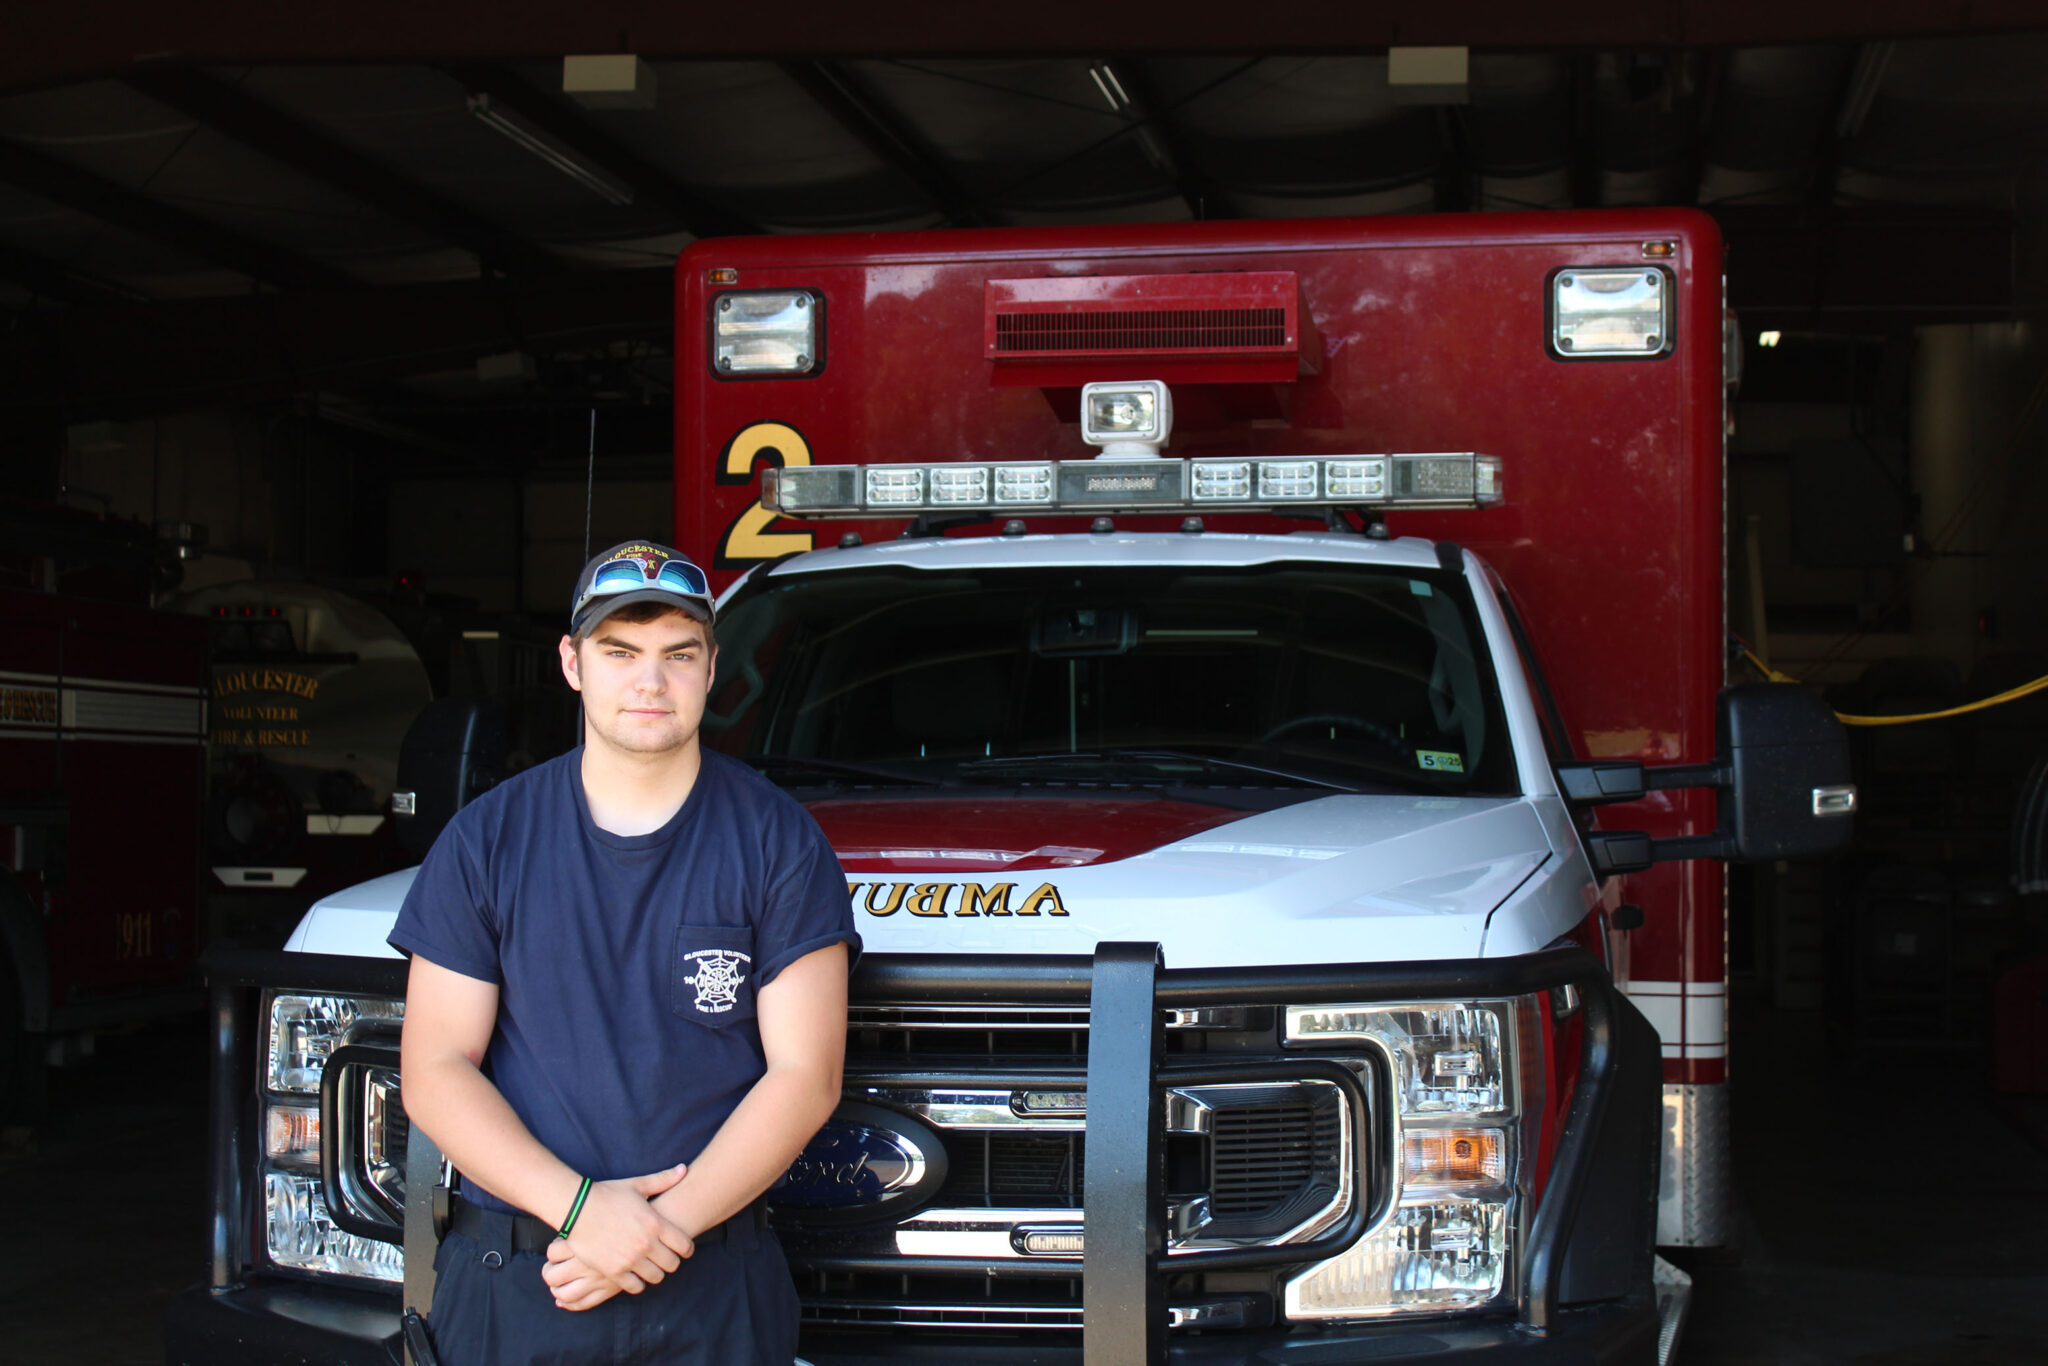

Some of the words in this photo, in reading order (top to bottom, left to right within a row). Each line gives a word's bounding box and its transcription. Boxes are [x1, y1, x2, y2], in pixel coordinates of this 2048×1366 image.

[715, 420, 814, 570] 2
[224, 706, 299, 720] VOLUNTEER
[243, 729, 255, 745] &
[257, 729, 312, 745] RESCUE
[1424, 755, 1435, 766] 5
[788, 1150, 868, 1186] ord
